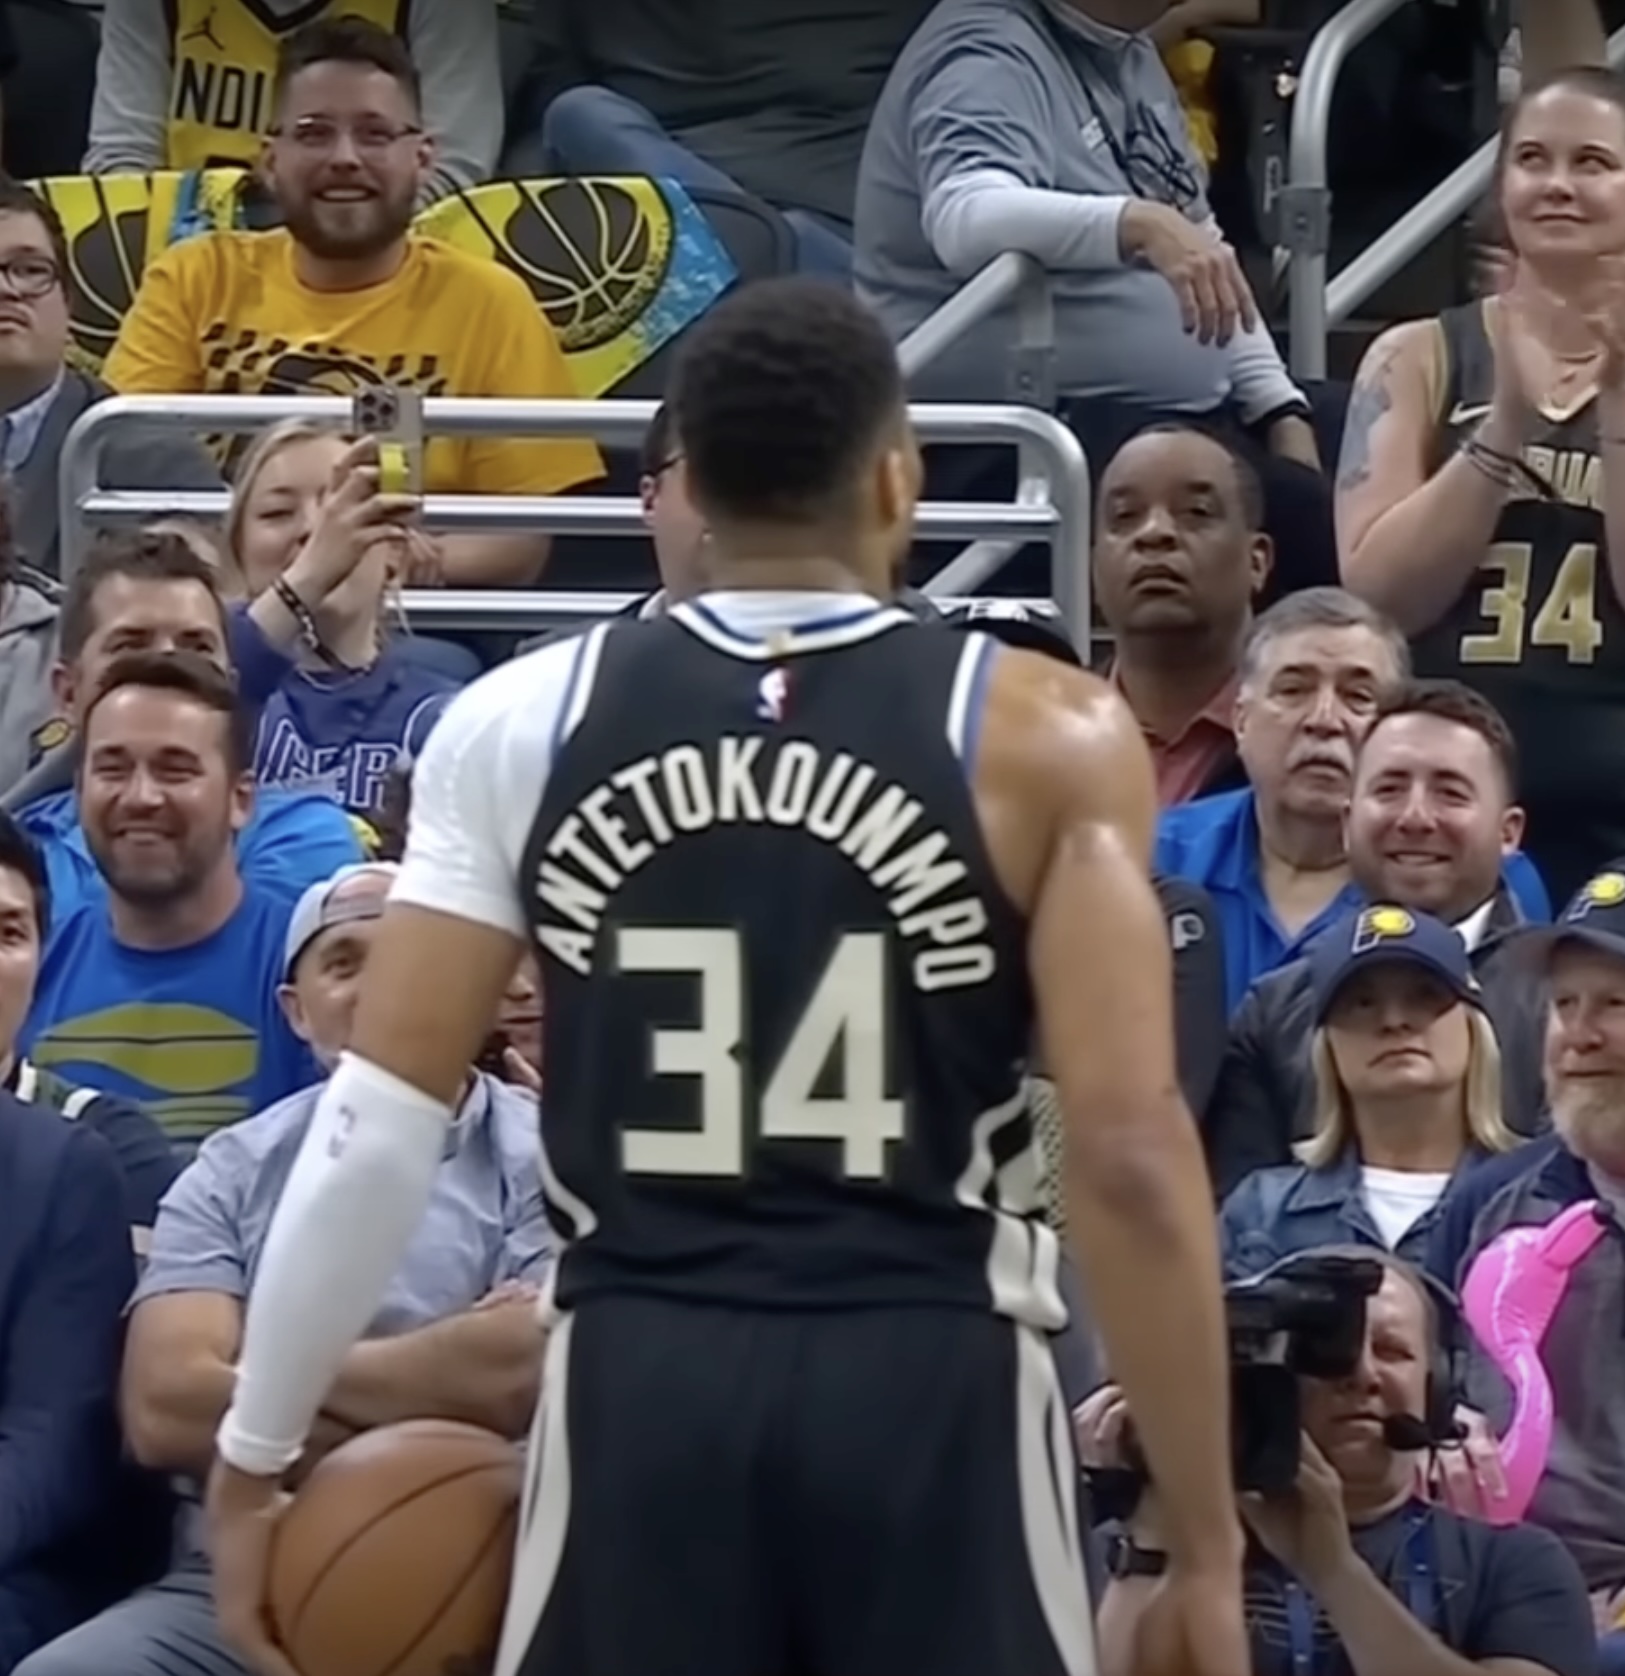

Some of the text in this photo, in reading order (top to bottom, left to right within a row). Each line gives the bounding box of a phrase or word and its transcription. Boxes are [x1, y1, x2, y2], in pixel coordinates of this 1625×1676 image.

[173, 56, 274, 136] NDI
[1459, 540, 1603, 664] 34
[535, 734, 997, 993] ANTETOKOUNMPO
[614, 925, 906, 1179] 34
